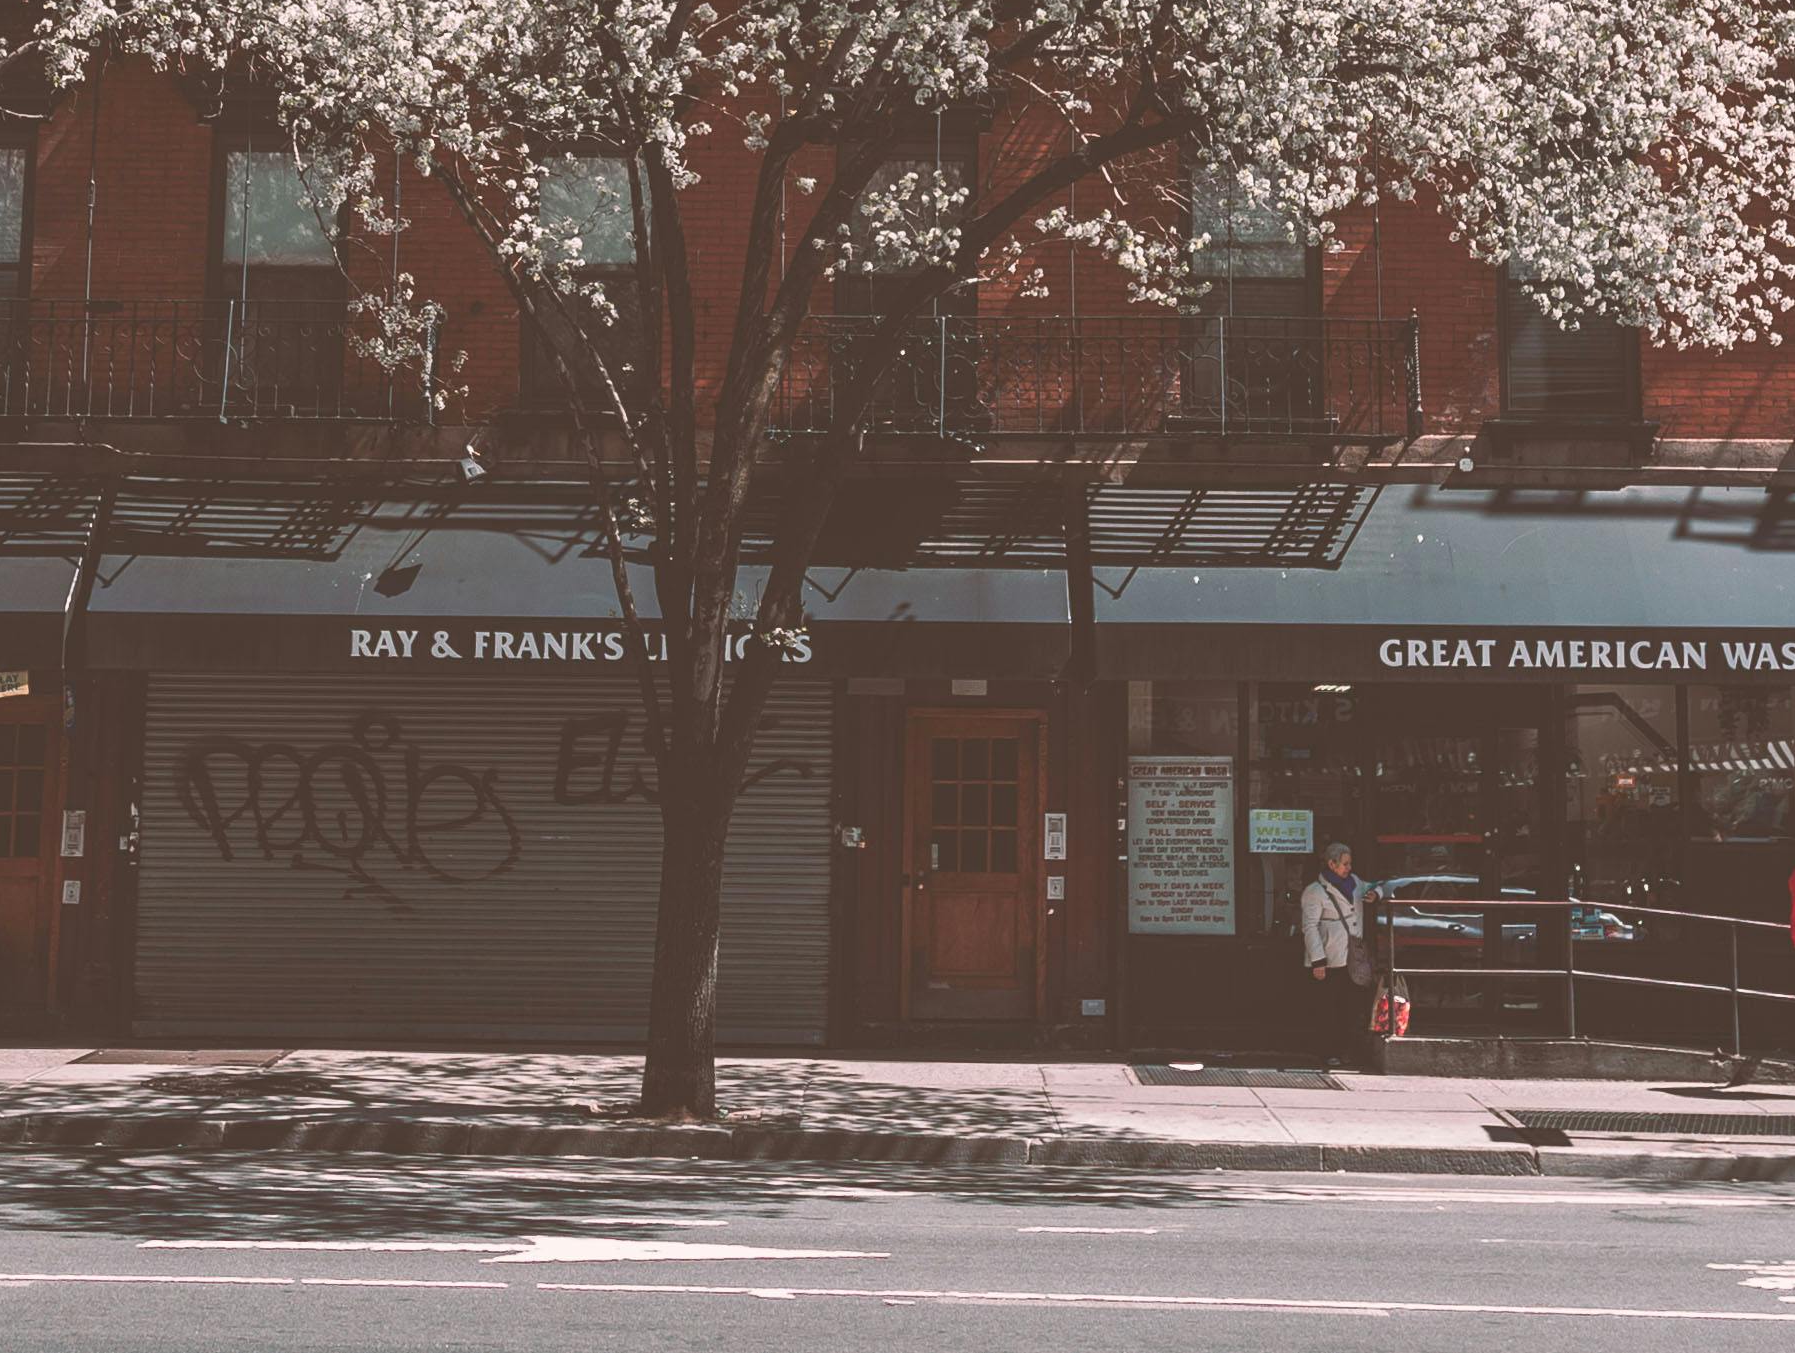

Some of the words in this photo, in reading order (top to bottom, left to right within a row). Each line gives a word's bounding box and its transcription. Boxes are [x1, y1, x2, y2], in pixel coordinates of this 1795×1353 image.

[350, 630, 419, 658] RAY
[430, 630, 463, 659] &
[474, 632, 624, 661] FRANK'S
[1379, 639, 1496, 668] GREAT
[1508, 640, 1708, 670] AMERICAN
[1160, 766, 1202, 776] AMERICAN
[1145, 800, 1167, 808] SELF
[1178, 800, 1216, 808] SERVICE
[1256, 811, 1308, 821] FREE
[1256, 827, 1307, 836] WI-FI
